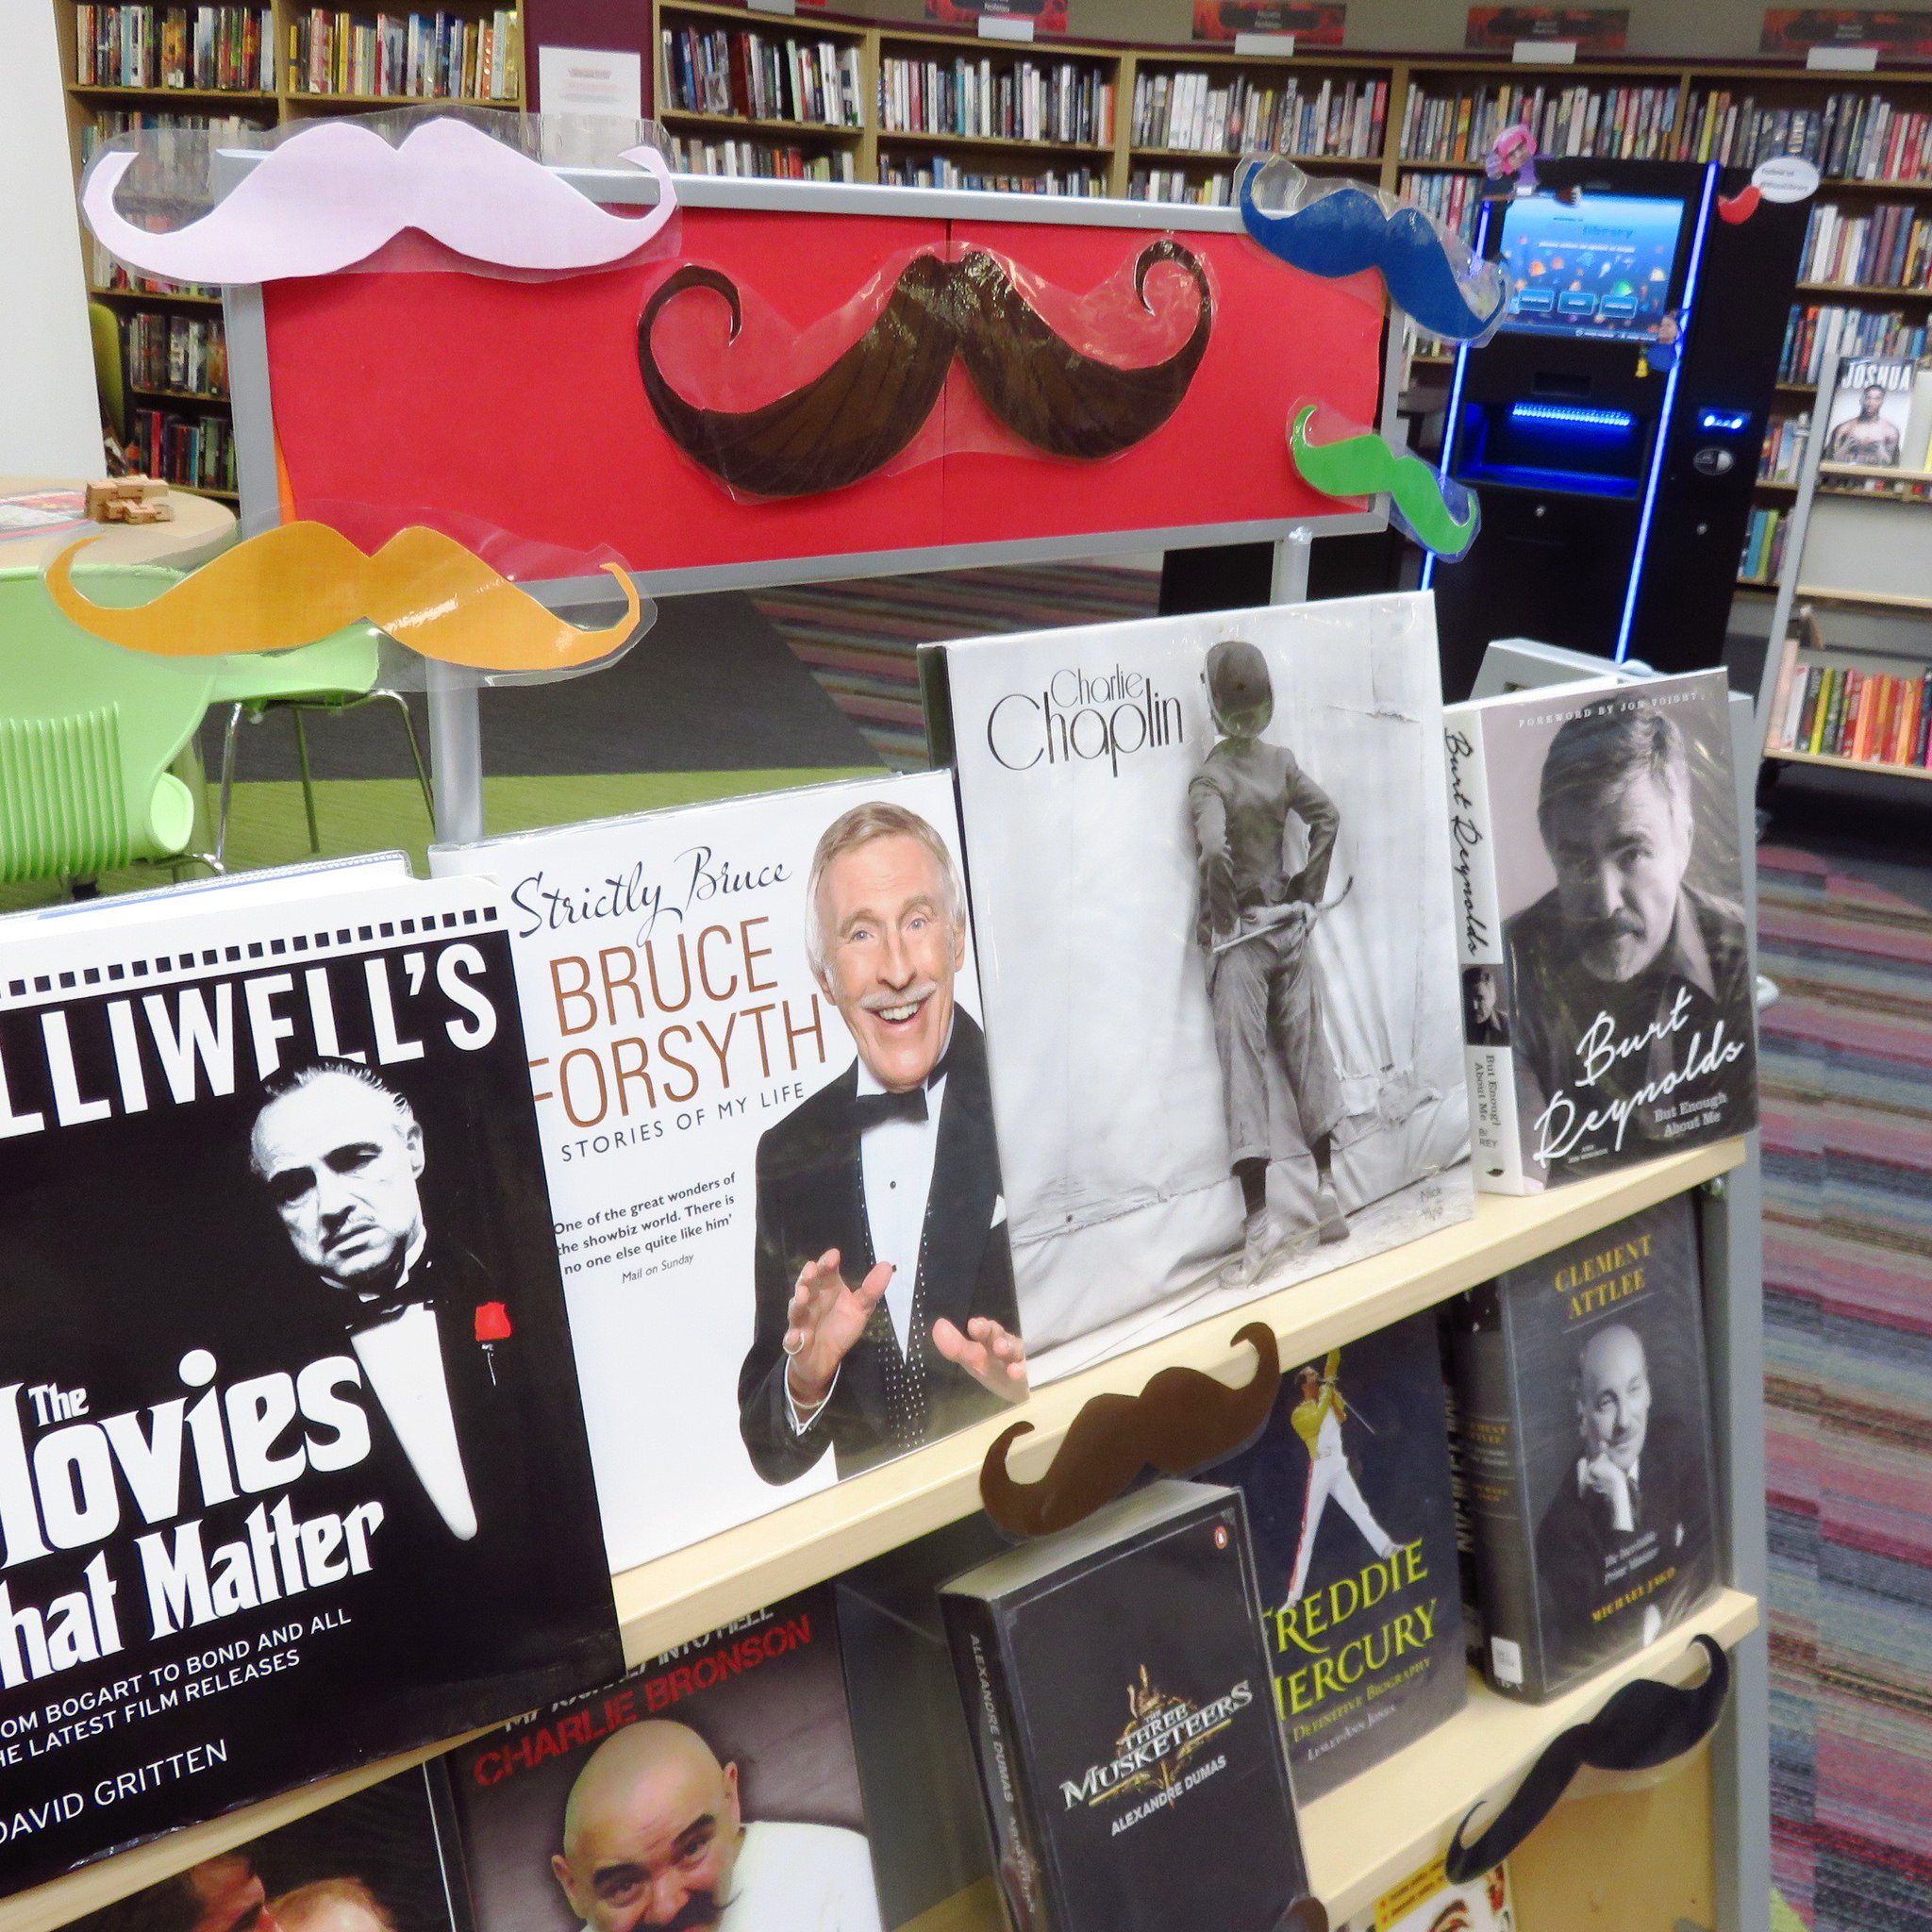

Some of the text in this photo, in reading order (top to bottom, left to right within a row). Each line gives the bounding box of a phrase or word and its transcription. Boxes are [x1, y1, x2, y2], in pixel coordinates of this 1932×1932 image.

[1840, 363, 1912, 391] JOSHUA
[1050, 663, 1145, 708] Charlie
[1518, 708, 1592, 728] FOREWORD
[1598, 703, 1614, 716] BY
[987, 677, 1184, 779] Chaplin
[1443, 726, 1490, 958] Burt Reynolds
[510, 845, 793, 949] Strictly Bruce
[549, 915, 779, 1038] BRUCE
[1574, 986, 1694, 1088] Burt
[561, 1082, 805, 1162] STORIES OF MY LIFE
[1532, 1019, 1746, 1170] Reynolds
[554, 1172, 736, 1235] One of the great wonders of
[558, 1194, 736, 1257] the showbiz world. There is
[564, 1262, 582, 1275] no
[586, 1255, 612, 1269] one
[616, 1243, 641, 1260] else
[644, 1233, 678, 1255] quite
[680, 1224, 703, 1241] like
[622, 1254, 695, 1284] Mail on Sunday
[1555, 1232, 1652, 1293] CLEMENT
[1569, 1267, 1646, 1320] ATTLEE
[27, 1381, 91, 1428] The
[133, 1493, 386, 1642] Matter
[1263, 1538, 1429, 1655] REDDIE
[29, 1709, 118, 1757] LATEST
[125, 1688, 179, 1724] FILM
[184, 1649, 302, 1703] RELEASES
[44, 1674, 143, 1725] BOGART
[148, 1662, 181, 1688] TO
[185, 1640, 251, 1684] BOND
[257, 1623, 304, 1652] AND
[309, 1608, 353, 1637] ALL
[474, 1689, 639, 1787] CHARLIE
[644, 1613, 812, 1714] BRONSON
[1058, 1679, 1255, 1813] MUSKETEERS
[1121, 1703, 1190, 1752] THREE
[93, 1738, 228, 1807] GRITTEN
[1110, 1755, 1228, 1838] ALEXANDRE DUMAS
